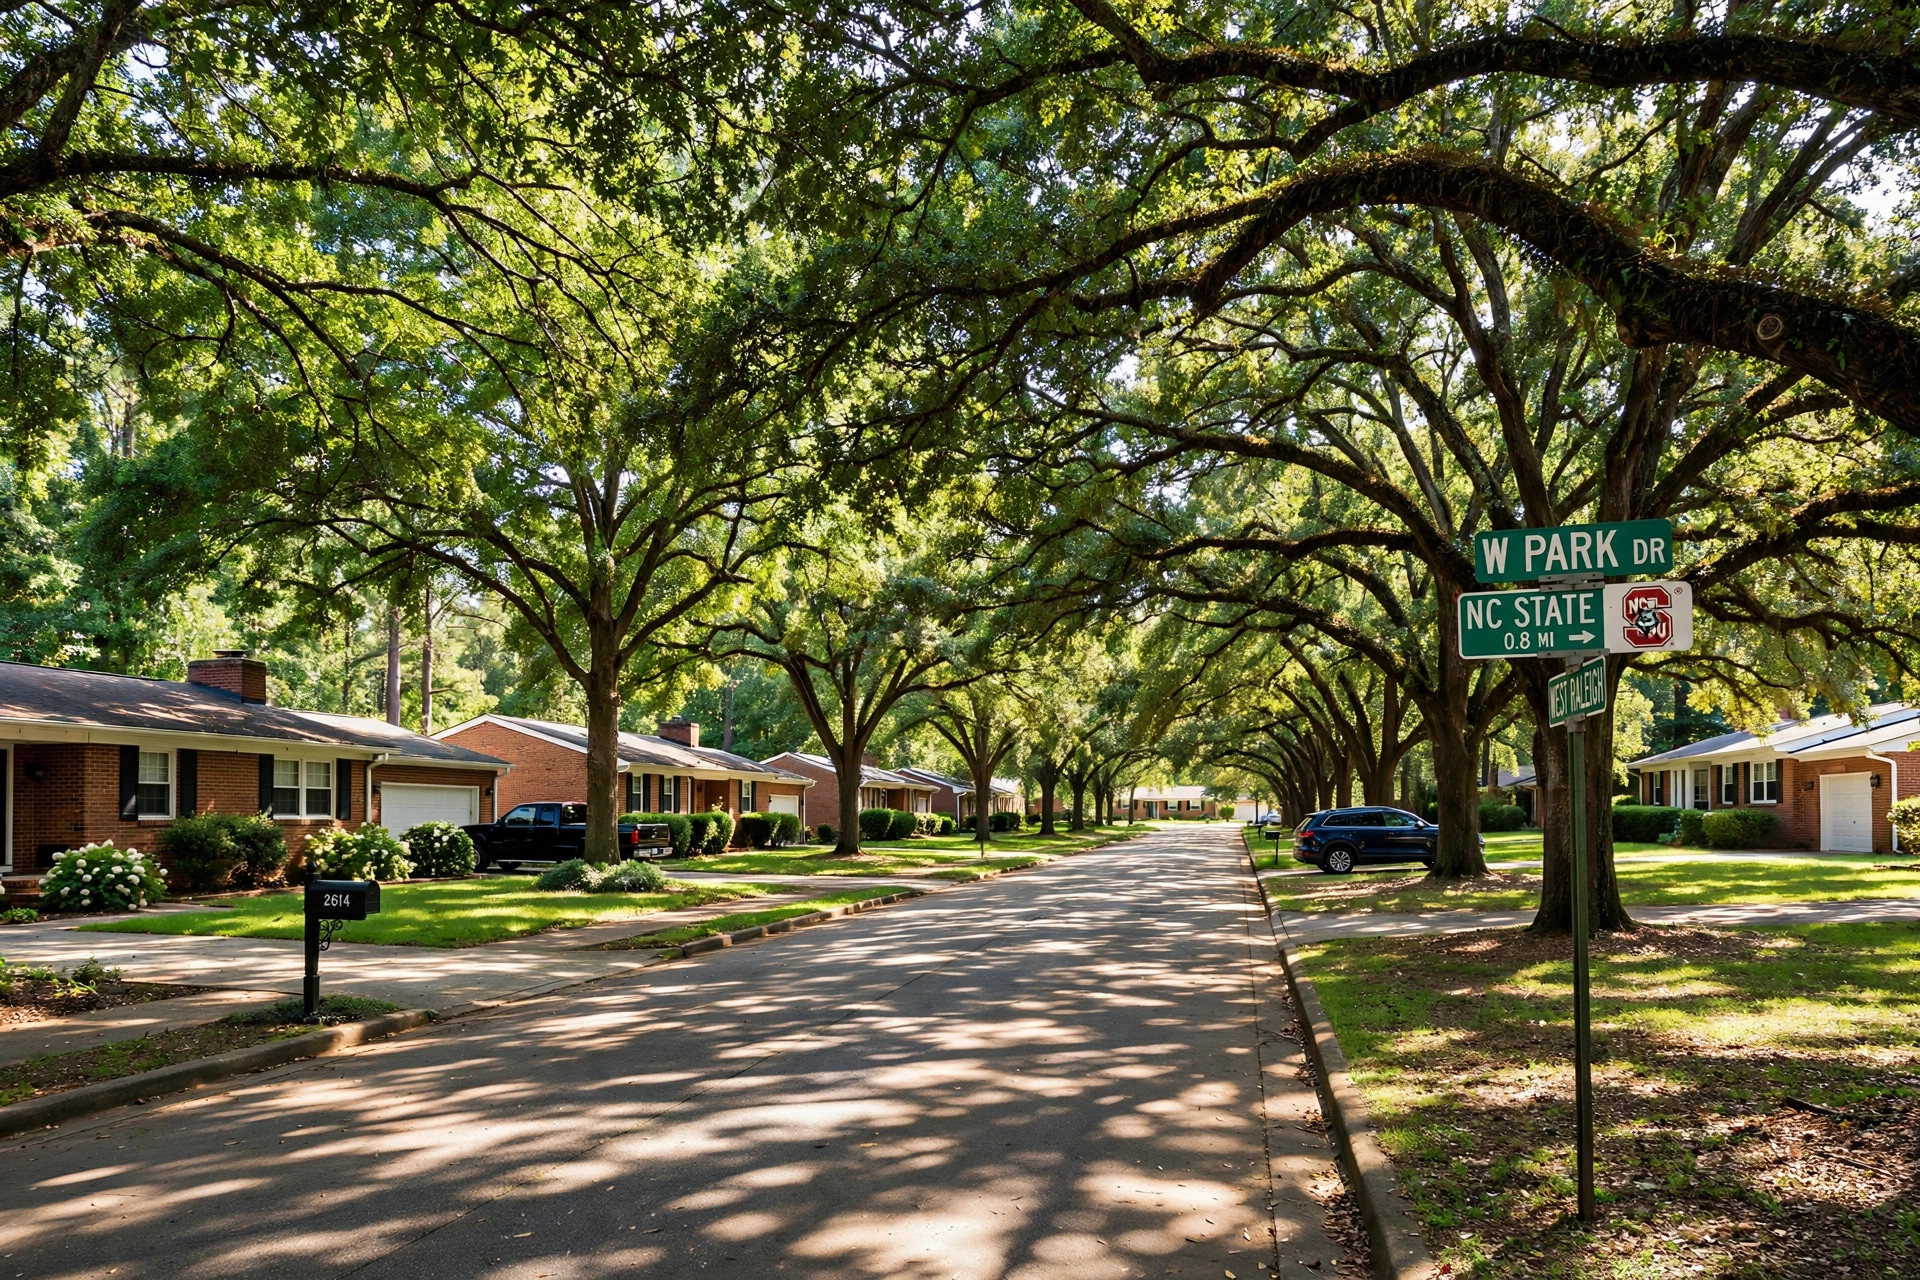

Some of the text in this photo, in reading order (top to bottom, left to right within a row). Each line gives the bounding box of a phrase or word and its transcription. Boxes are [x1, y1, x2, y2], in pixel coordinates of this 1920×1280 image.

[1482, 529, 1666, 575] W PARK DR
[1467, 592, 1596, 630] NC STATE
[1504, 631, 1554, 650] 0.8 MI
[1550, 666, 1604, 719] WEST RALEIGH
[323, 893, 350, 907] 2614
